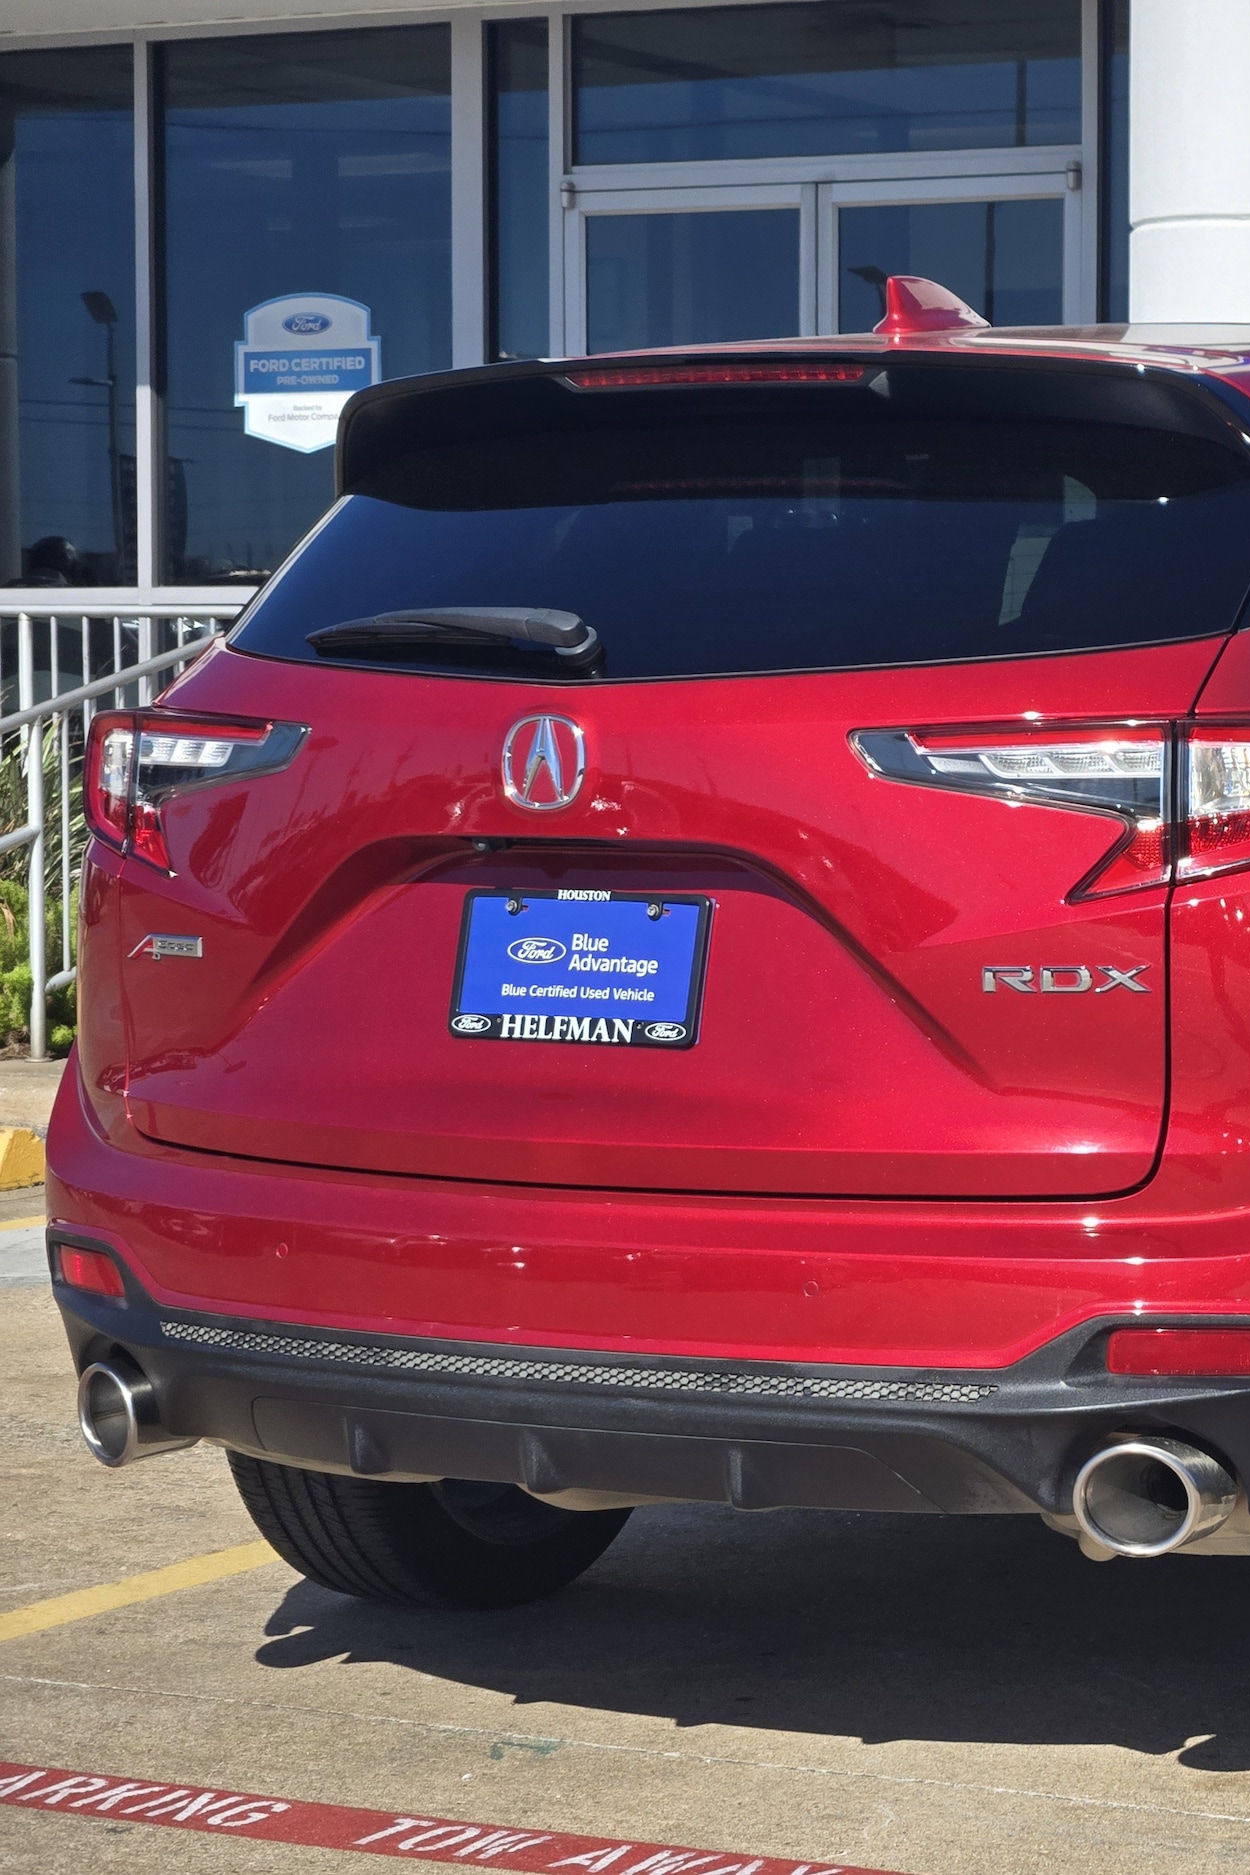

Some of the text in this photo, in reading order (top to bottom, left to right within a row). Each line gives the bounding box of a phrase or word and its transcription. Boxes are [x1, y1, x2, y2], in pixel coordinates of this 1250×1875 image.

[291, 315, 322, 331] Ford
[250, 356, 365, 373] FORD CERTIFIED
[276, 375, 339, 386] PRE-OWNED
[268, 412, 339, 422] Ford Motor Compa
[558, 889, 611, 902] HOUSTON
[518, 939, 555, 960] Ford
[571, 933, 609, 952] Blue
[568, 954, 659, 977] Advantage
[982, 964, 1152, 993] RDX
[501, 984, 655, 1002] Blue Certified Used Vehicle
[457, 1015, 485, 1031] Ford
[499, 1013, 635, 1044] HELFMAN
[652, 1023, 679, 1040] Ford
[0, 1771, 291, 1827] ARKING
[353, 1818, 553, 1860] TOW
